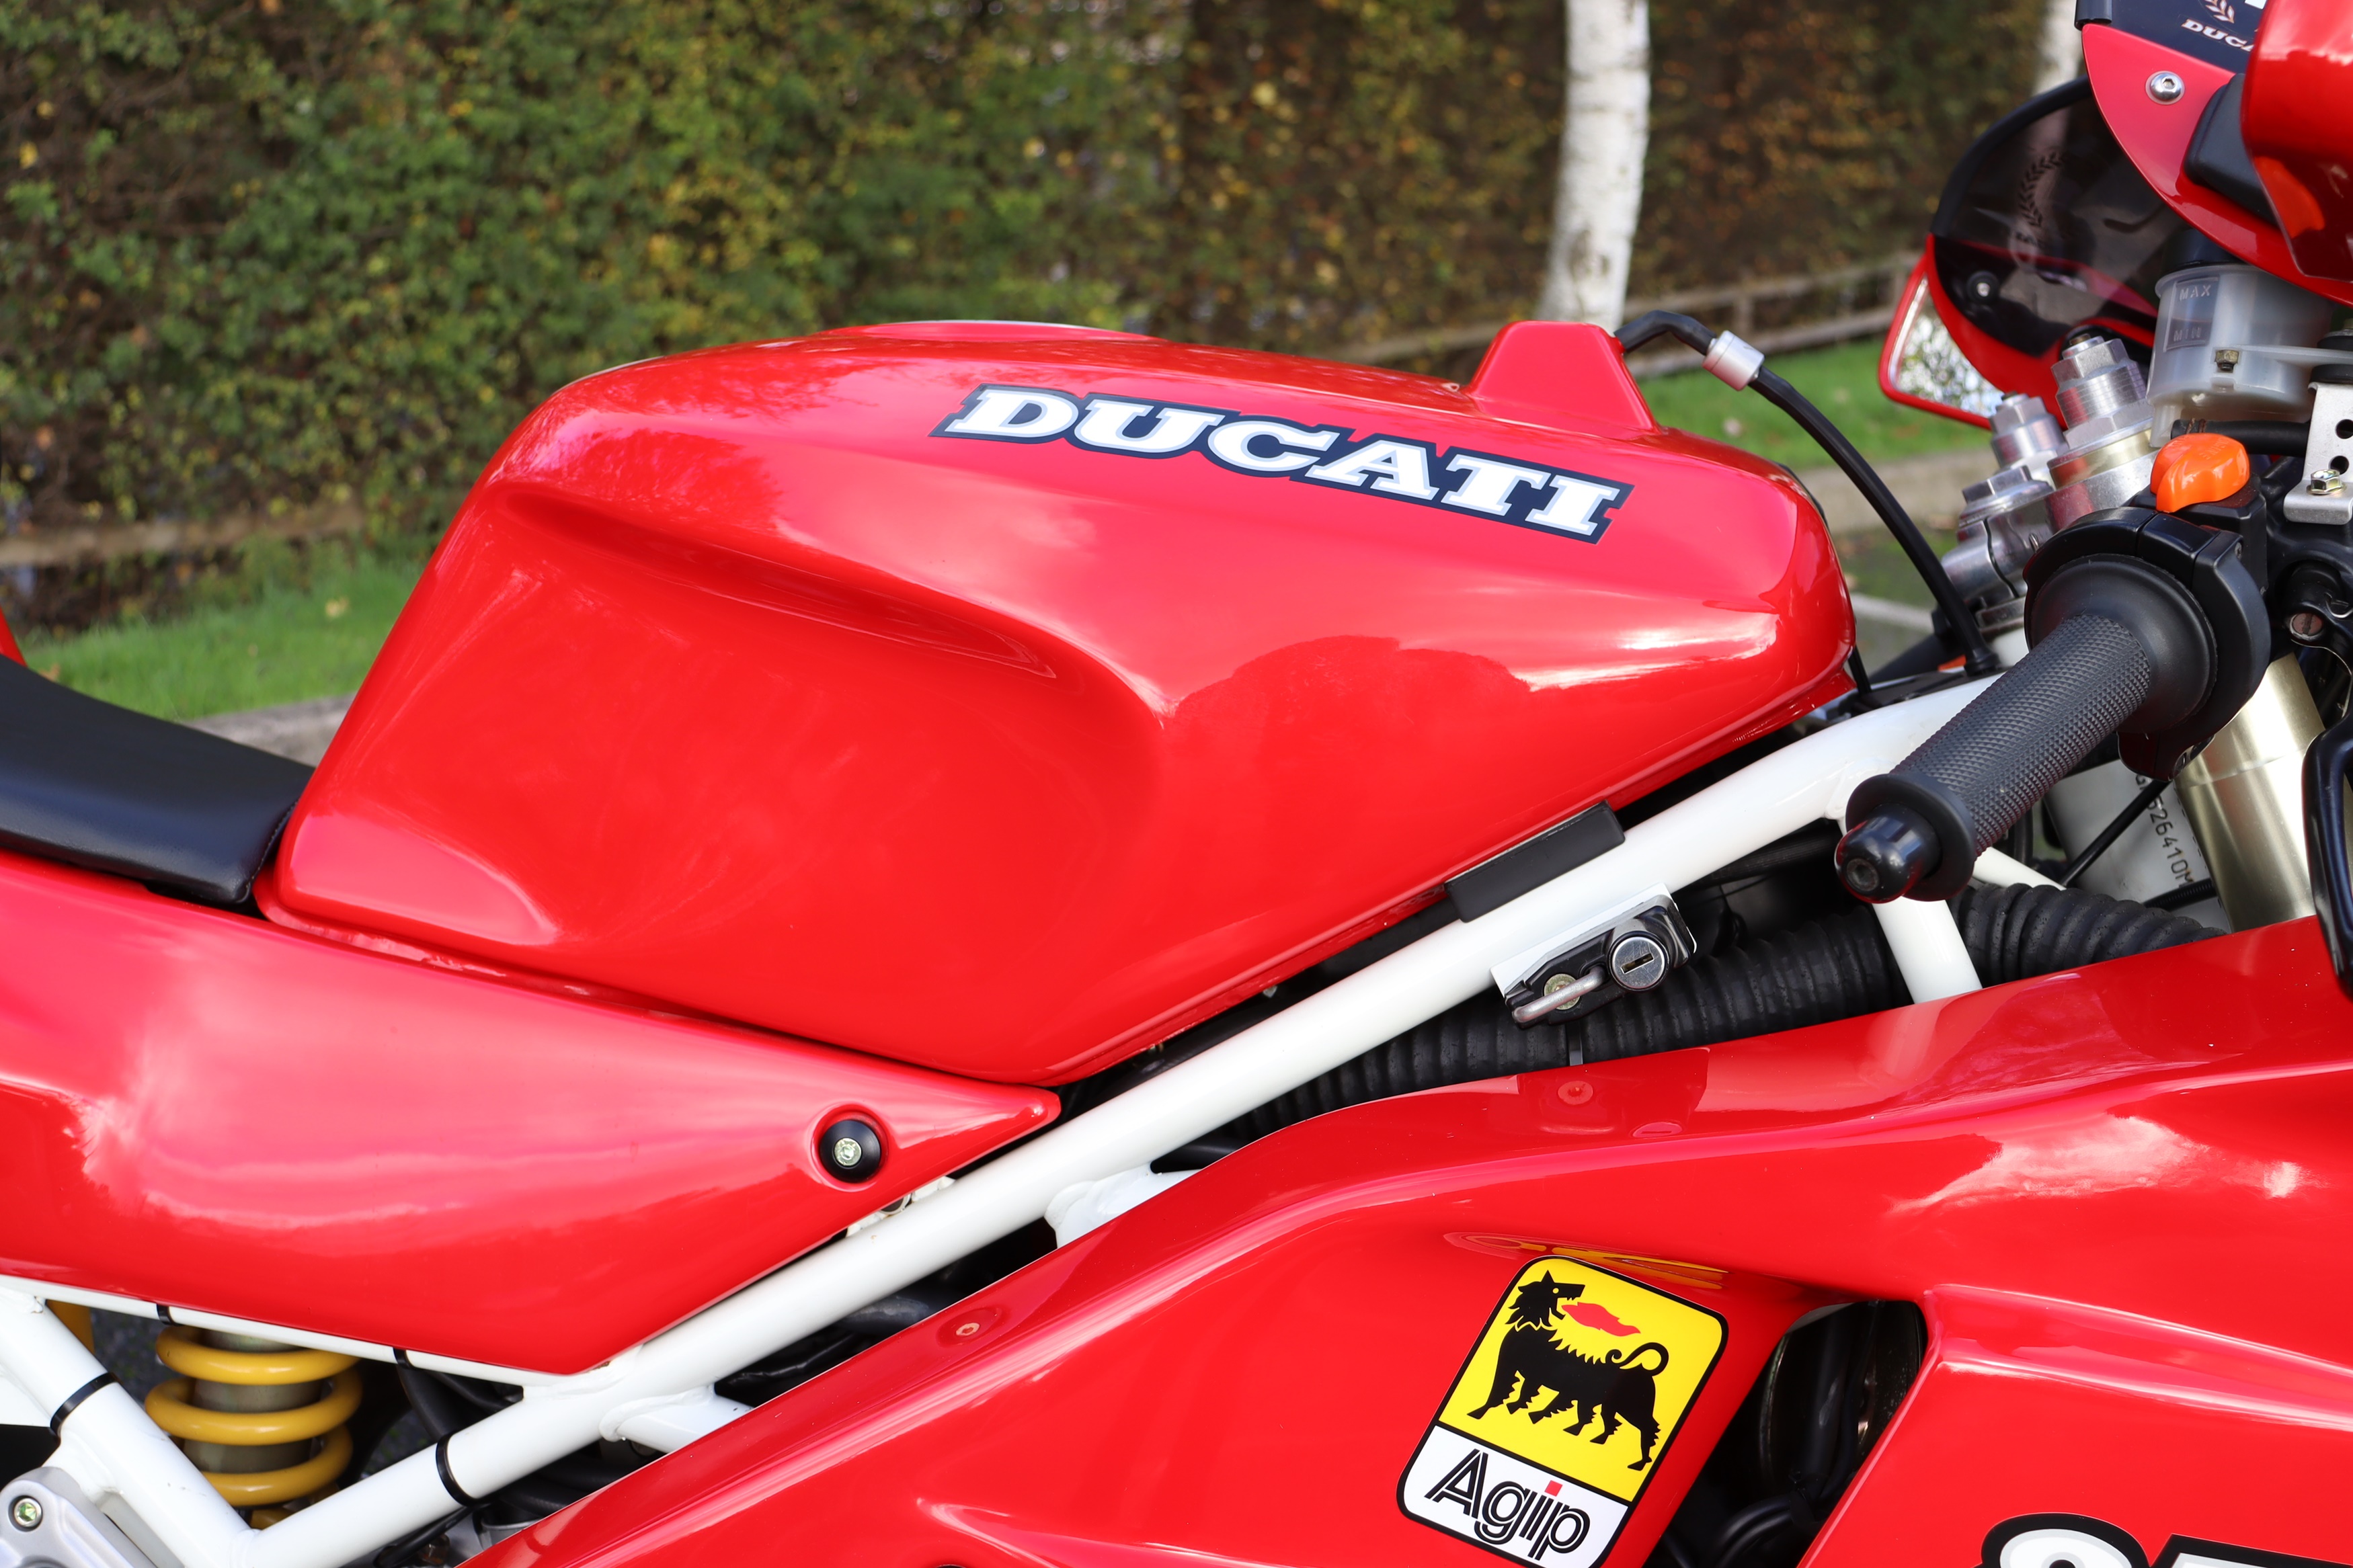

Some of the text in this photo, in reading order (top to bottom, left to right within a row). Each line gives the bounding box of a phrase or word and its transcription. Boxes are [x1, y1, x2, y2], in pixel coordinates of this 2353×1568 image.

[2180, 285, 2211, 301] MAX
[2173, 327, 2202, 341] MIN
[943, 384, 1618, 536] DUCATI
[1424, 1448, 1591, 1561] Agip
